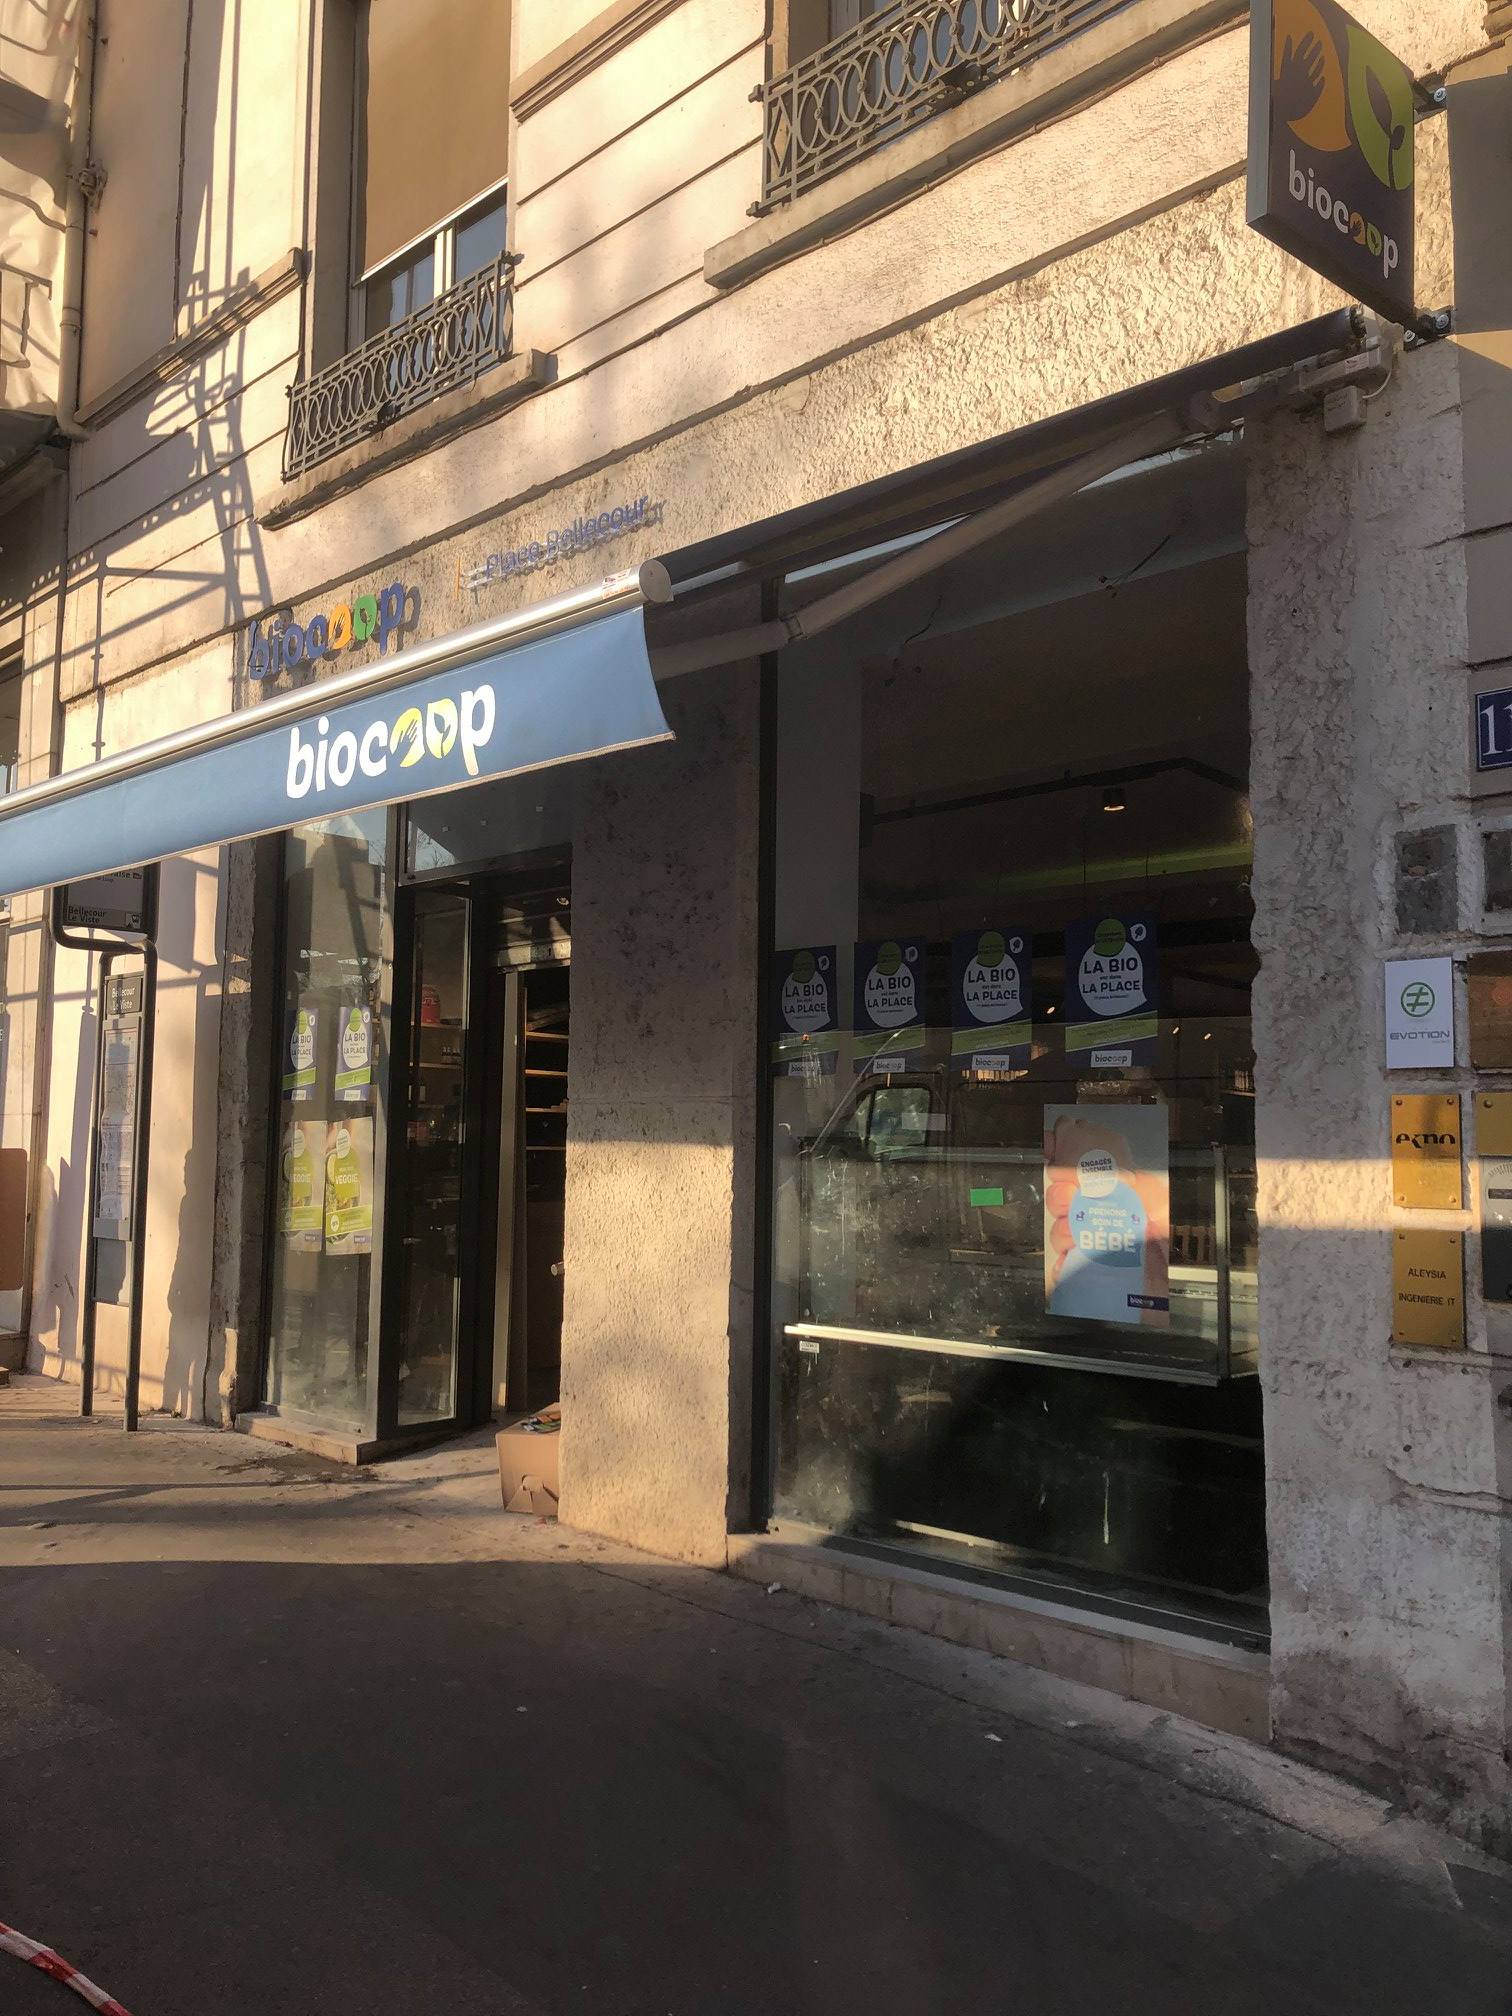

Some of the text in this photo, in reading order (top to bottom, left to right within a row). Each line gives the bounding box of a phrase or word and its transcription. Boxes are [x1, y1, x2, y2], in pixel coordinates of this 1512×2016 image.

[1289, 149, 1399, 279] biocoop
[248, 581, 405, 681] biocoop
[286, 683, 496, 799] biocoop
[68, 905, 106, 918] Bellecour
[68, 914, 101, 924] Le Viste
[1084, 958, 1138, 974] LA BIO
[968, 968, 1016, 983] LA BIO
[868, 976, 911, 991] LA BIO
[1083, 981, 1140, 993] LA PLACE
[112, 986, 136, 999] Bellecour
[785, 984, 824, 998] LA BIO
[966, 990, 1018, 1001] LA PLACE
[784, 1003, 826, 1014] LA PLACE
[867, 997, 913, 1008] LA PLACE
[301, 1035, 311, 1043] BIO
[345, 1033, 365, 1042] LA BIO
[1390, 1031, 1450, 1041] EVOTION
[336, 1174, 358, 1184] VEGGIE
[1080, 1228, 1137, 1252] BÉBÉ
[1408, 1268, 1446, 1280] ALEYSIA
[1447, 1298, 1455, 1306] IT
